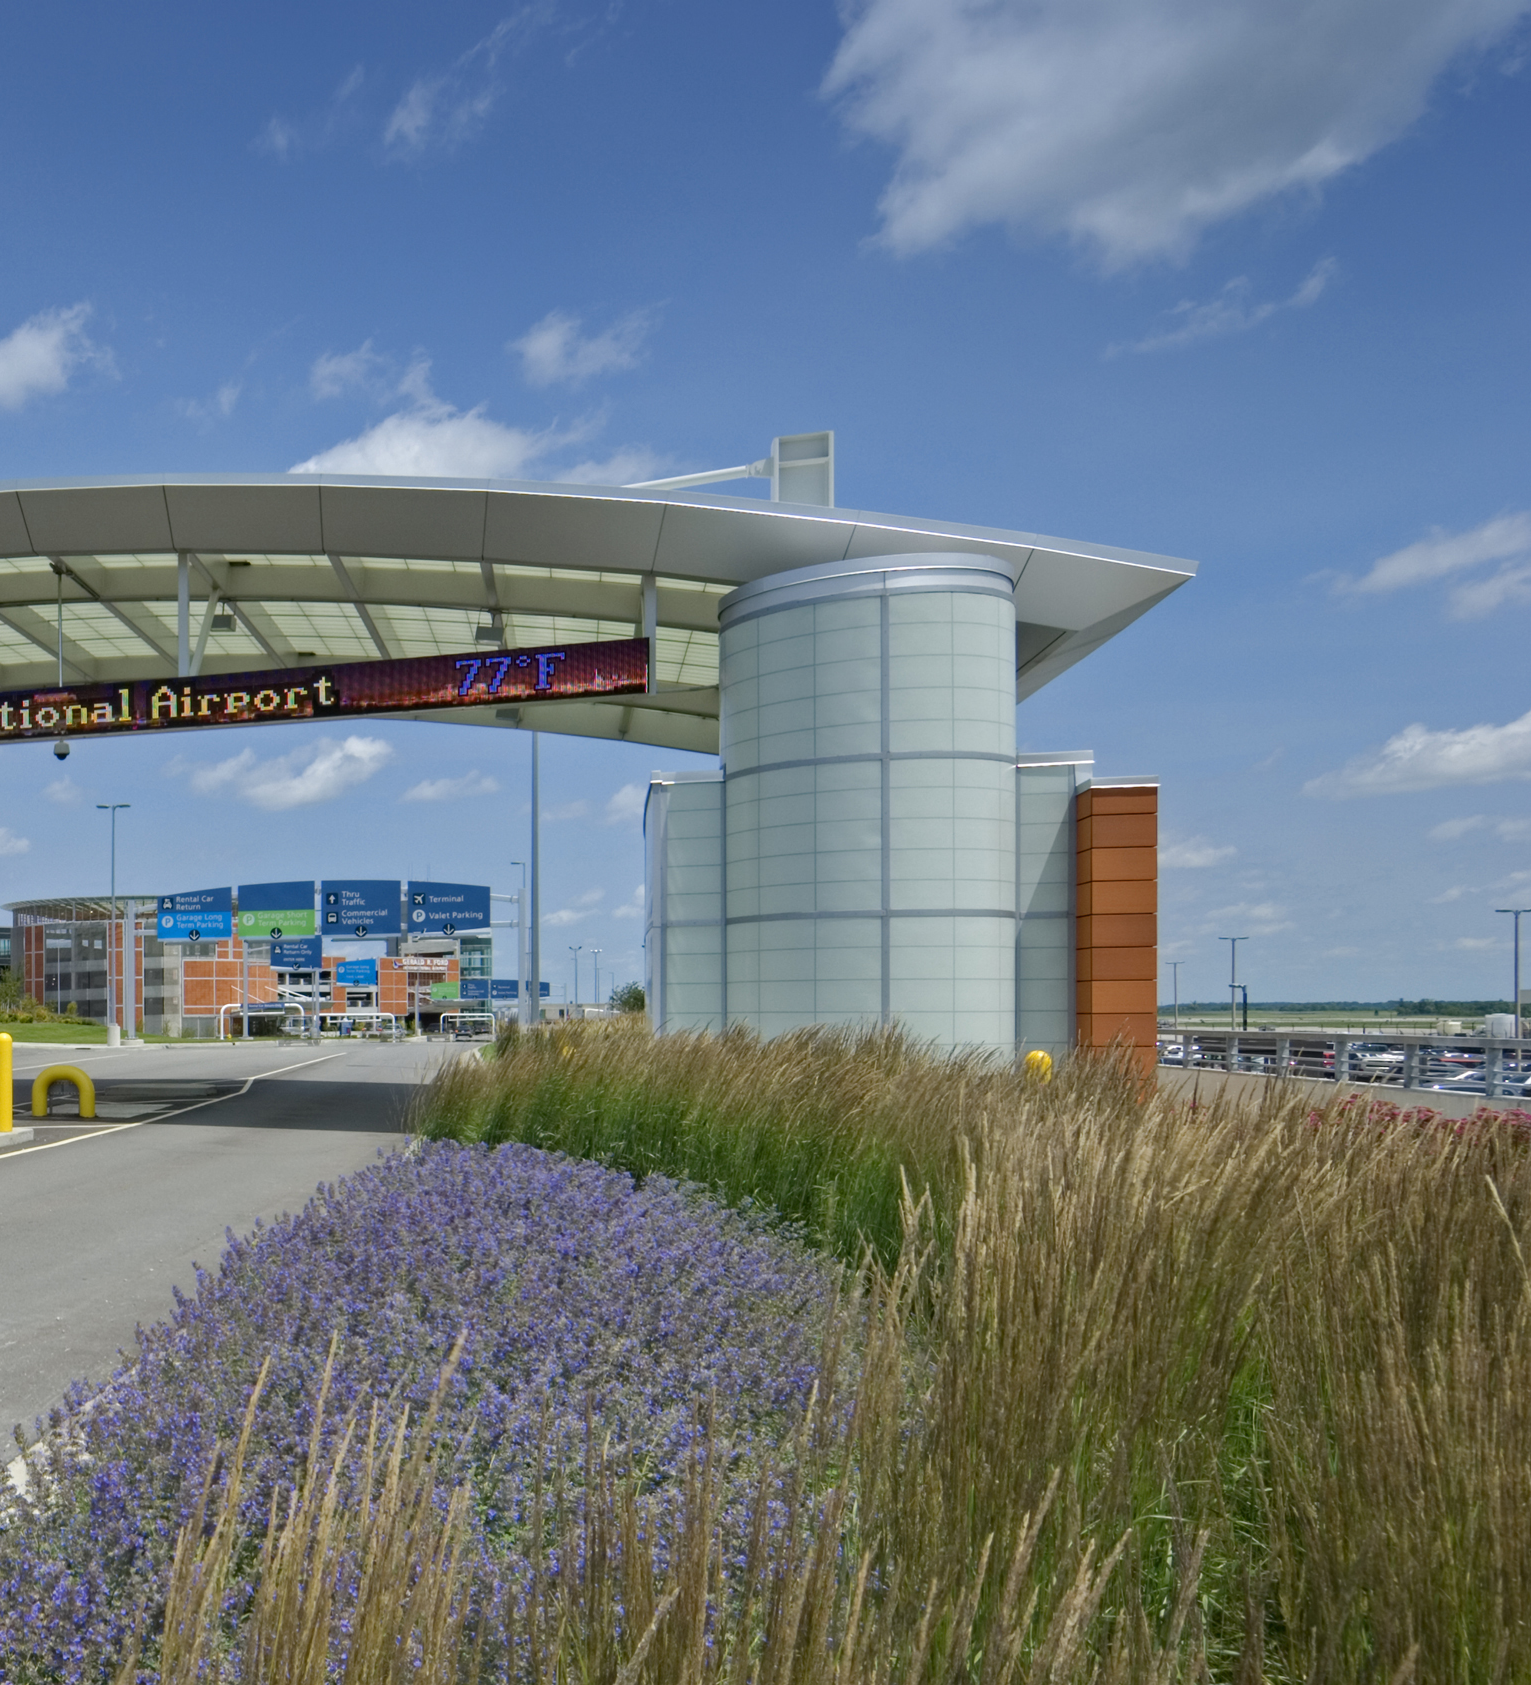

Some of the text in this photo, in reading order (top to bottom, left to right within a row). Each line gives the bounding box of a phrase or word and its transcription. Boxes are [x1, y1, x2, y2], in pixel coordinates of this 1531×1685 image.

[455, 652, 566, 696] 77°F
[151, 675, 335, 720] Airport
[429, 895, 464, 903] Terminal
[257, 911, 307, 920] Garage Short
[341, 909, 388, 917] Commercial
[452, 911, 483, 920] Parking
[176, 914, 223, 922] Garage Long
[342, 917, 374, 925] Vehicles
[196, 921, 224, 929] Parking
[278, 919, 307, 927] Parking
